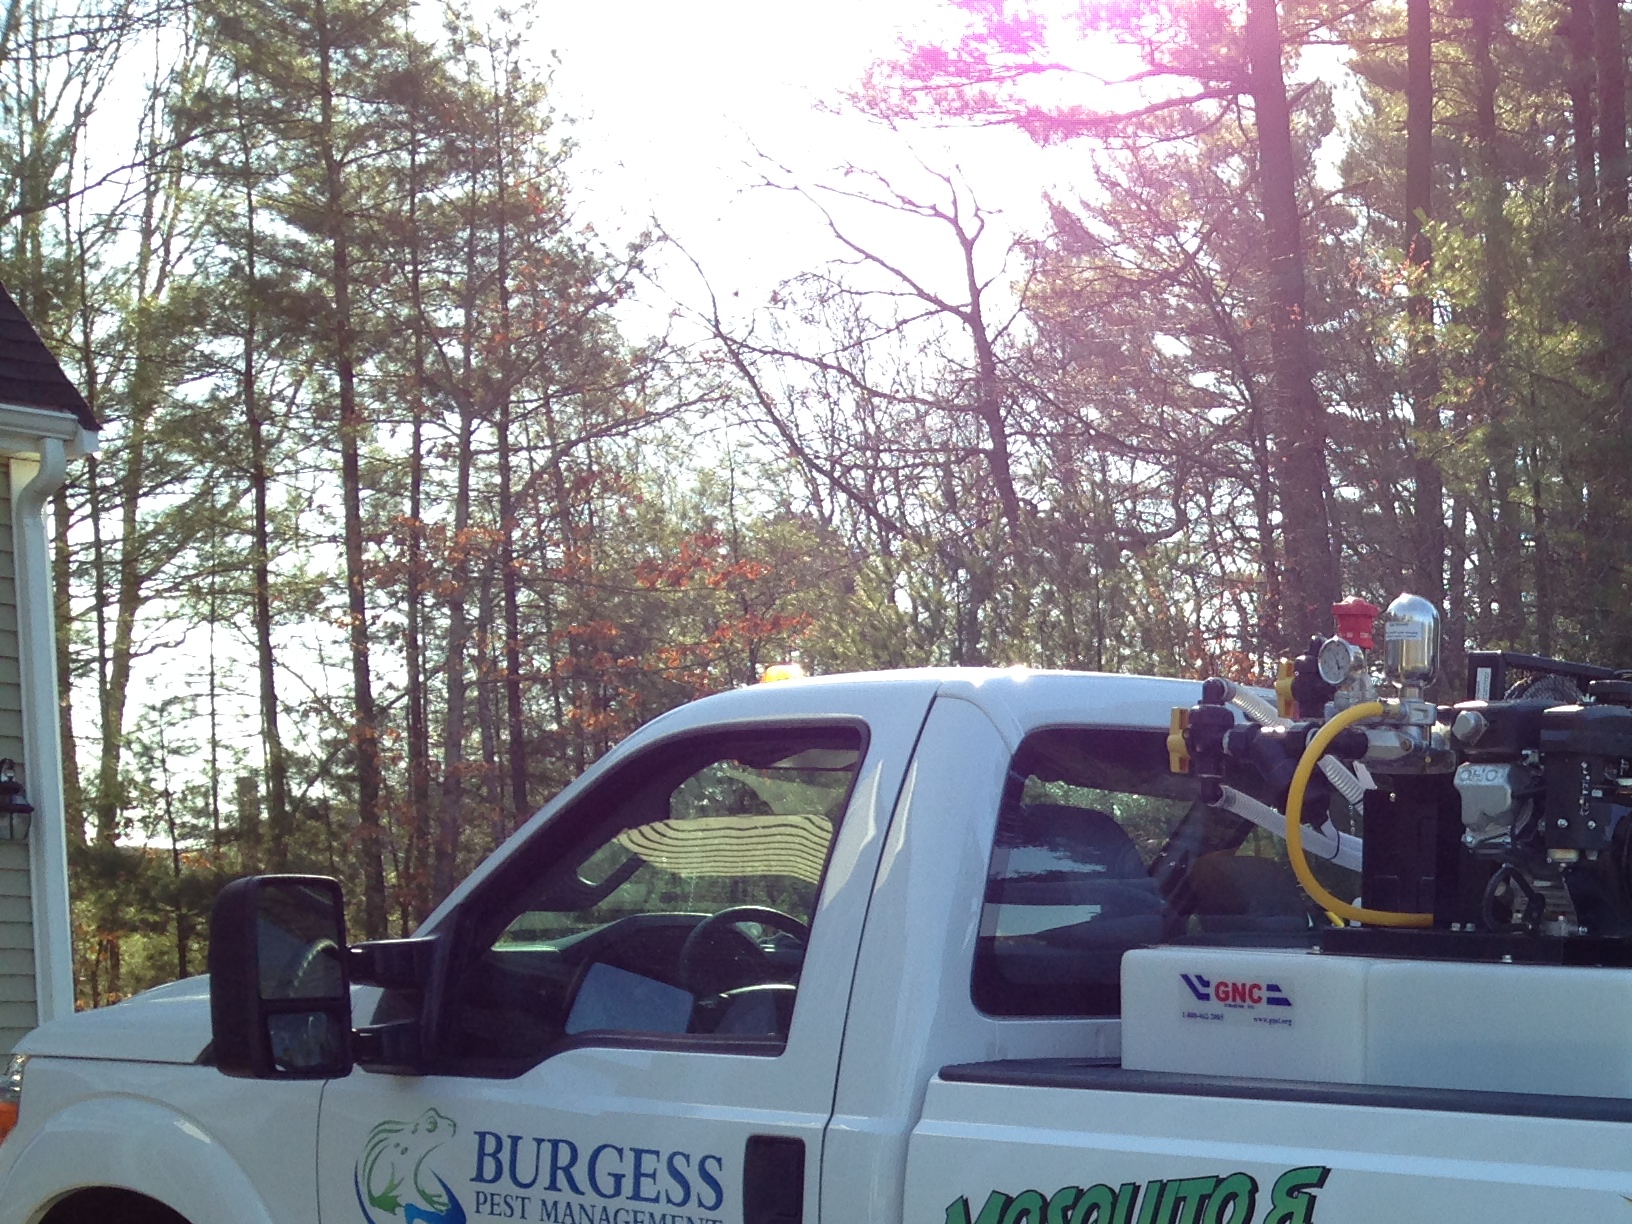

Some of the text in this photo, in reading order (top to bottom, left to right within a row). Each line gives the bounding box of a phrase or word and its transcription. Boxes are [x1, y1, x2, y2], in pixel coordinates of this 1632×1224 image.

[1214, 981, 1263, 1004] GNC
[470, 1130, 724, 1211] BURGESS
[474, 1191, 531, 1219] PEST
